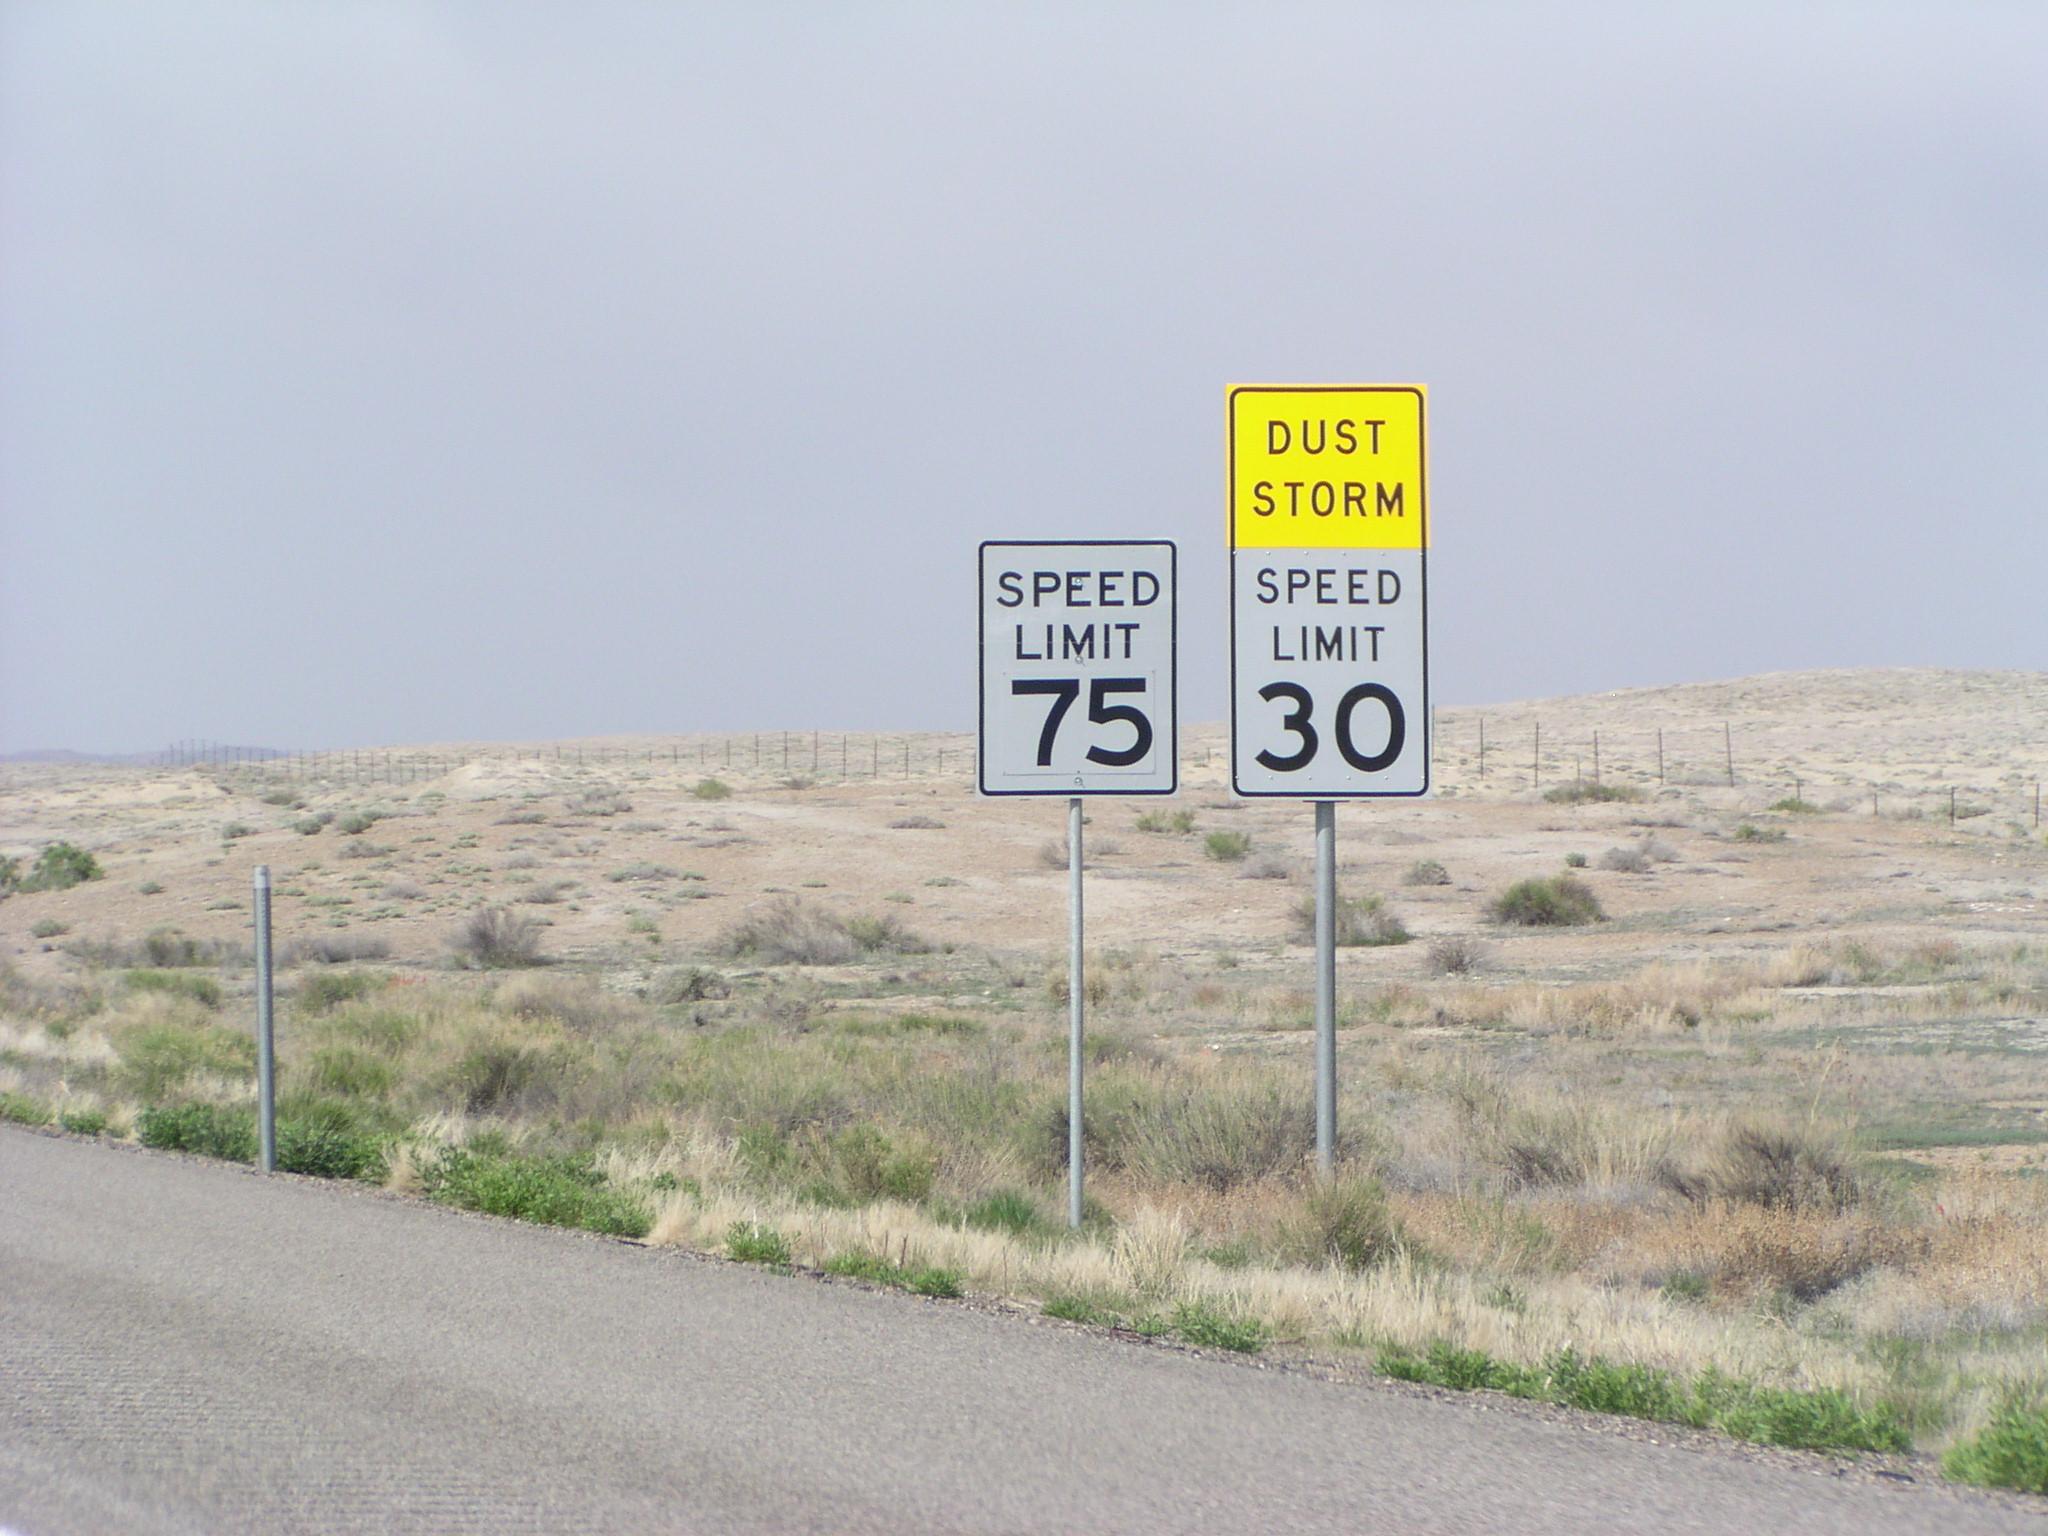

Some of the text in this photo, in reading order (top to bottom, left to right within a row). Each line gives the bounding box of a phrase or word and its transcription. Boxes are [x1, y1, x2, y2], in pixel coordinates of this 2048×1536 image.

[1268, 420, 1386, 455] DUST
[1253, 482, 1404, 517] STORM
[996, 570, 1161, 608] SPEED
[1256, 567, 1402, 605] SPEED
[1016, 623, 1141, 661] LIMIT
[1273, 625, 1386, 662] LIMIT
[1011, 677, 1154, 768] 75
[1255, 681, 1407, 773] 30
